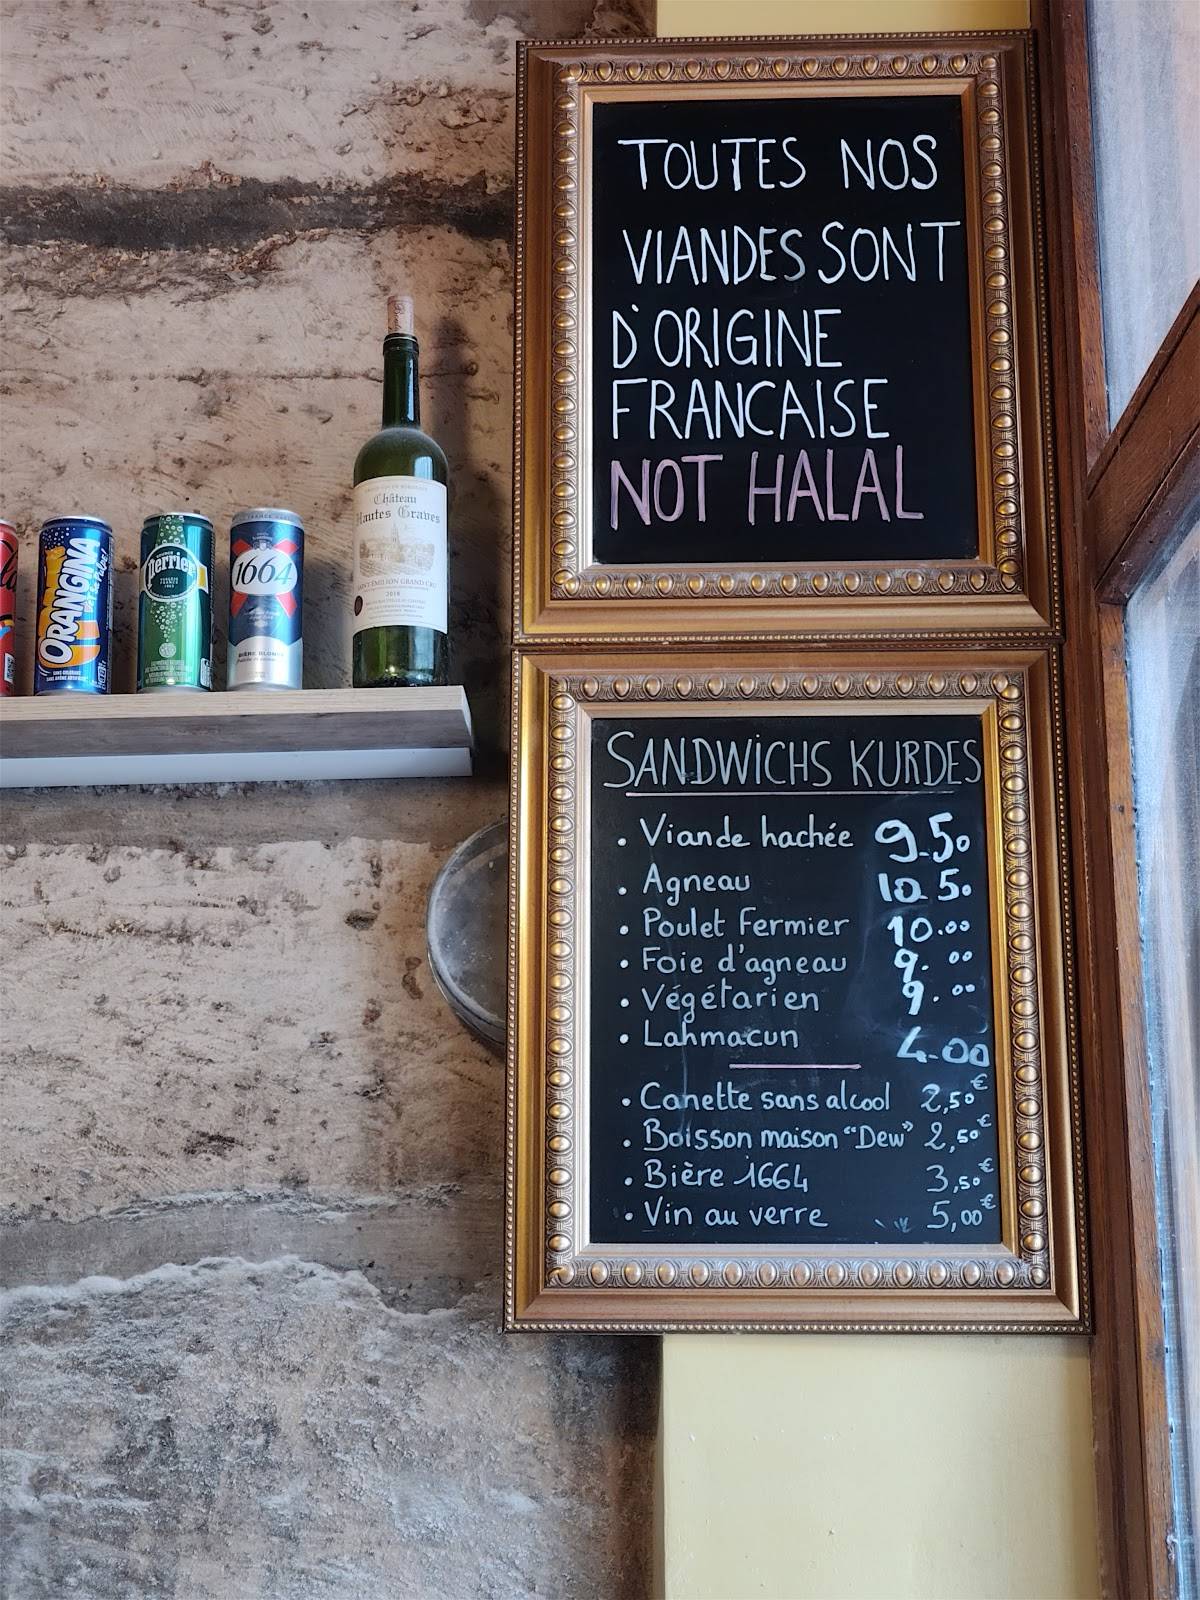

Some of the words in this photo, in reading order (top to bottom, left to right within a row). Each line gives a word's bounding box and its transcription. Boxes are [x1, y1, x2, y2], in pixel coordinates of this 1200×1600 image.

[618, 137, 806, 190] TOUTES
[841, 135, 938, 190] NOS
[622, 225, 806, 285] VIANDES
[818, 220, 961, 284] SONT
[612, 378, 890, 440] FRANCAISE
[610, 454, 723, 530] NOT
[748, 444, 925, 527] HALAL
[236, 554, 293, 587] 1664
[39, 537, 101, 664] ORANGINA
[850, 738, 982, 787] KURDES
[640, 813, 751, 848] Viande
[761, 814, 854, 849] hachée
[643, 863, 750, 906] Agneau
[643, 907, 726, 938] Poulet
[738, 907, 850, 936] Fermier
[642, 946, 704, 974] Foie
[718, 943, 847, 986] d'agneau
[641, 982, 820, 1024] Végétarien
[643, 1019, 799, 1048] Lahmacun
[760, 1089, 818, 1111] sans
[825, 1079, 891, 1112] alcool
[643, 1118, 753, 1152] Boisson
[760, 1128, 839, 1150] maison
[643, 1159, 725, 1189] Bière
[732, 1155, 810, 1193] 1664
[643, 1195, 693, 1228] Vin
[704, 1205, 739, 1227] au
[748, 1206, 829, 1228] verre
